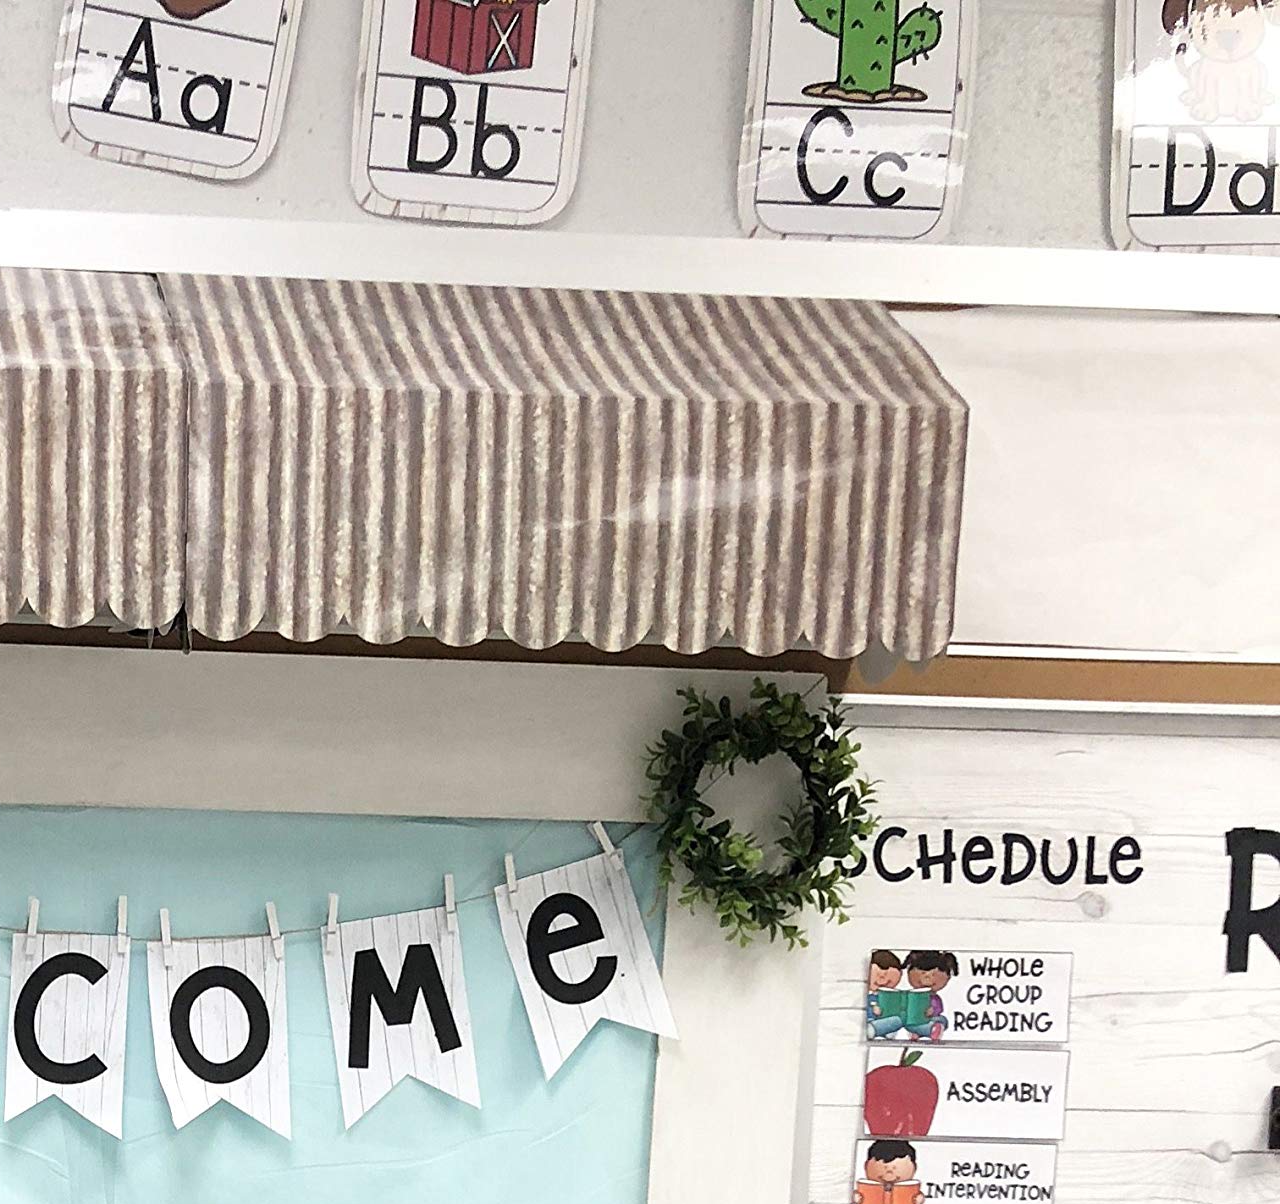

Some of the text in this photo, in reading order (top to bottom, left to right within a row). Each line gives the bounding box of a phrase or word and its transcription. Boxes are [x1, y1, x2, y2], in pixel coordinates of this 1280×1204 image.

[99, 17, 233, 138] Aa
[406, 78, 523, 179] Bb
[796, 108, 910, 207] Cc
[966, 983, 1043, 1006] GROUP
